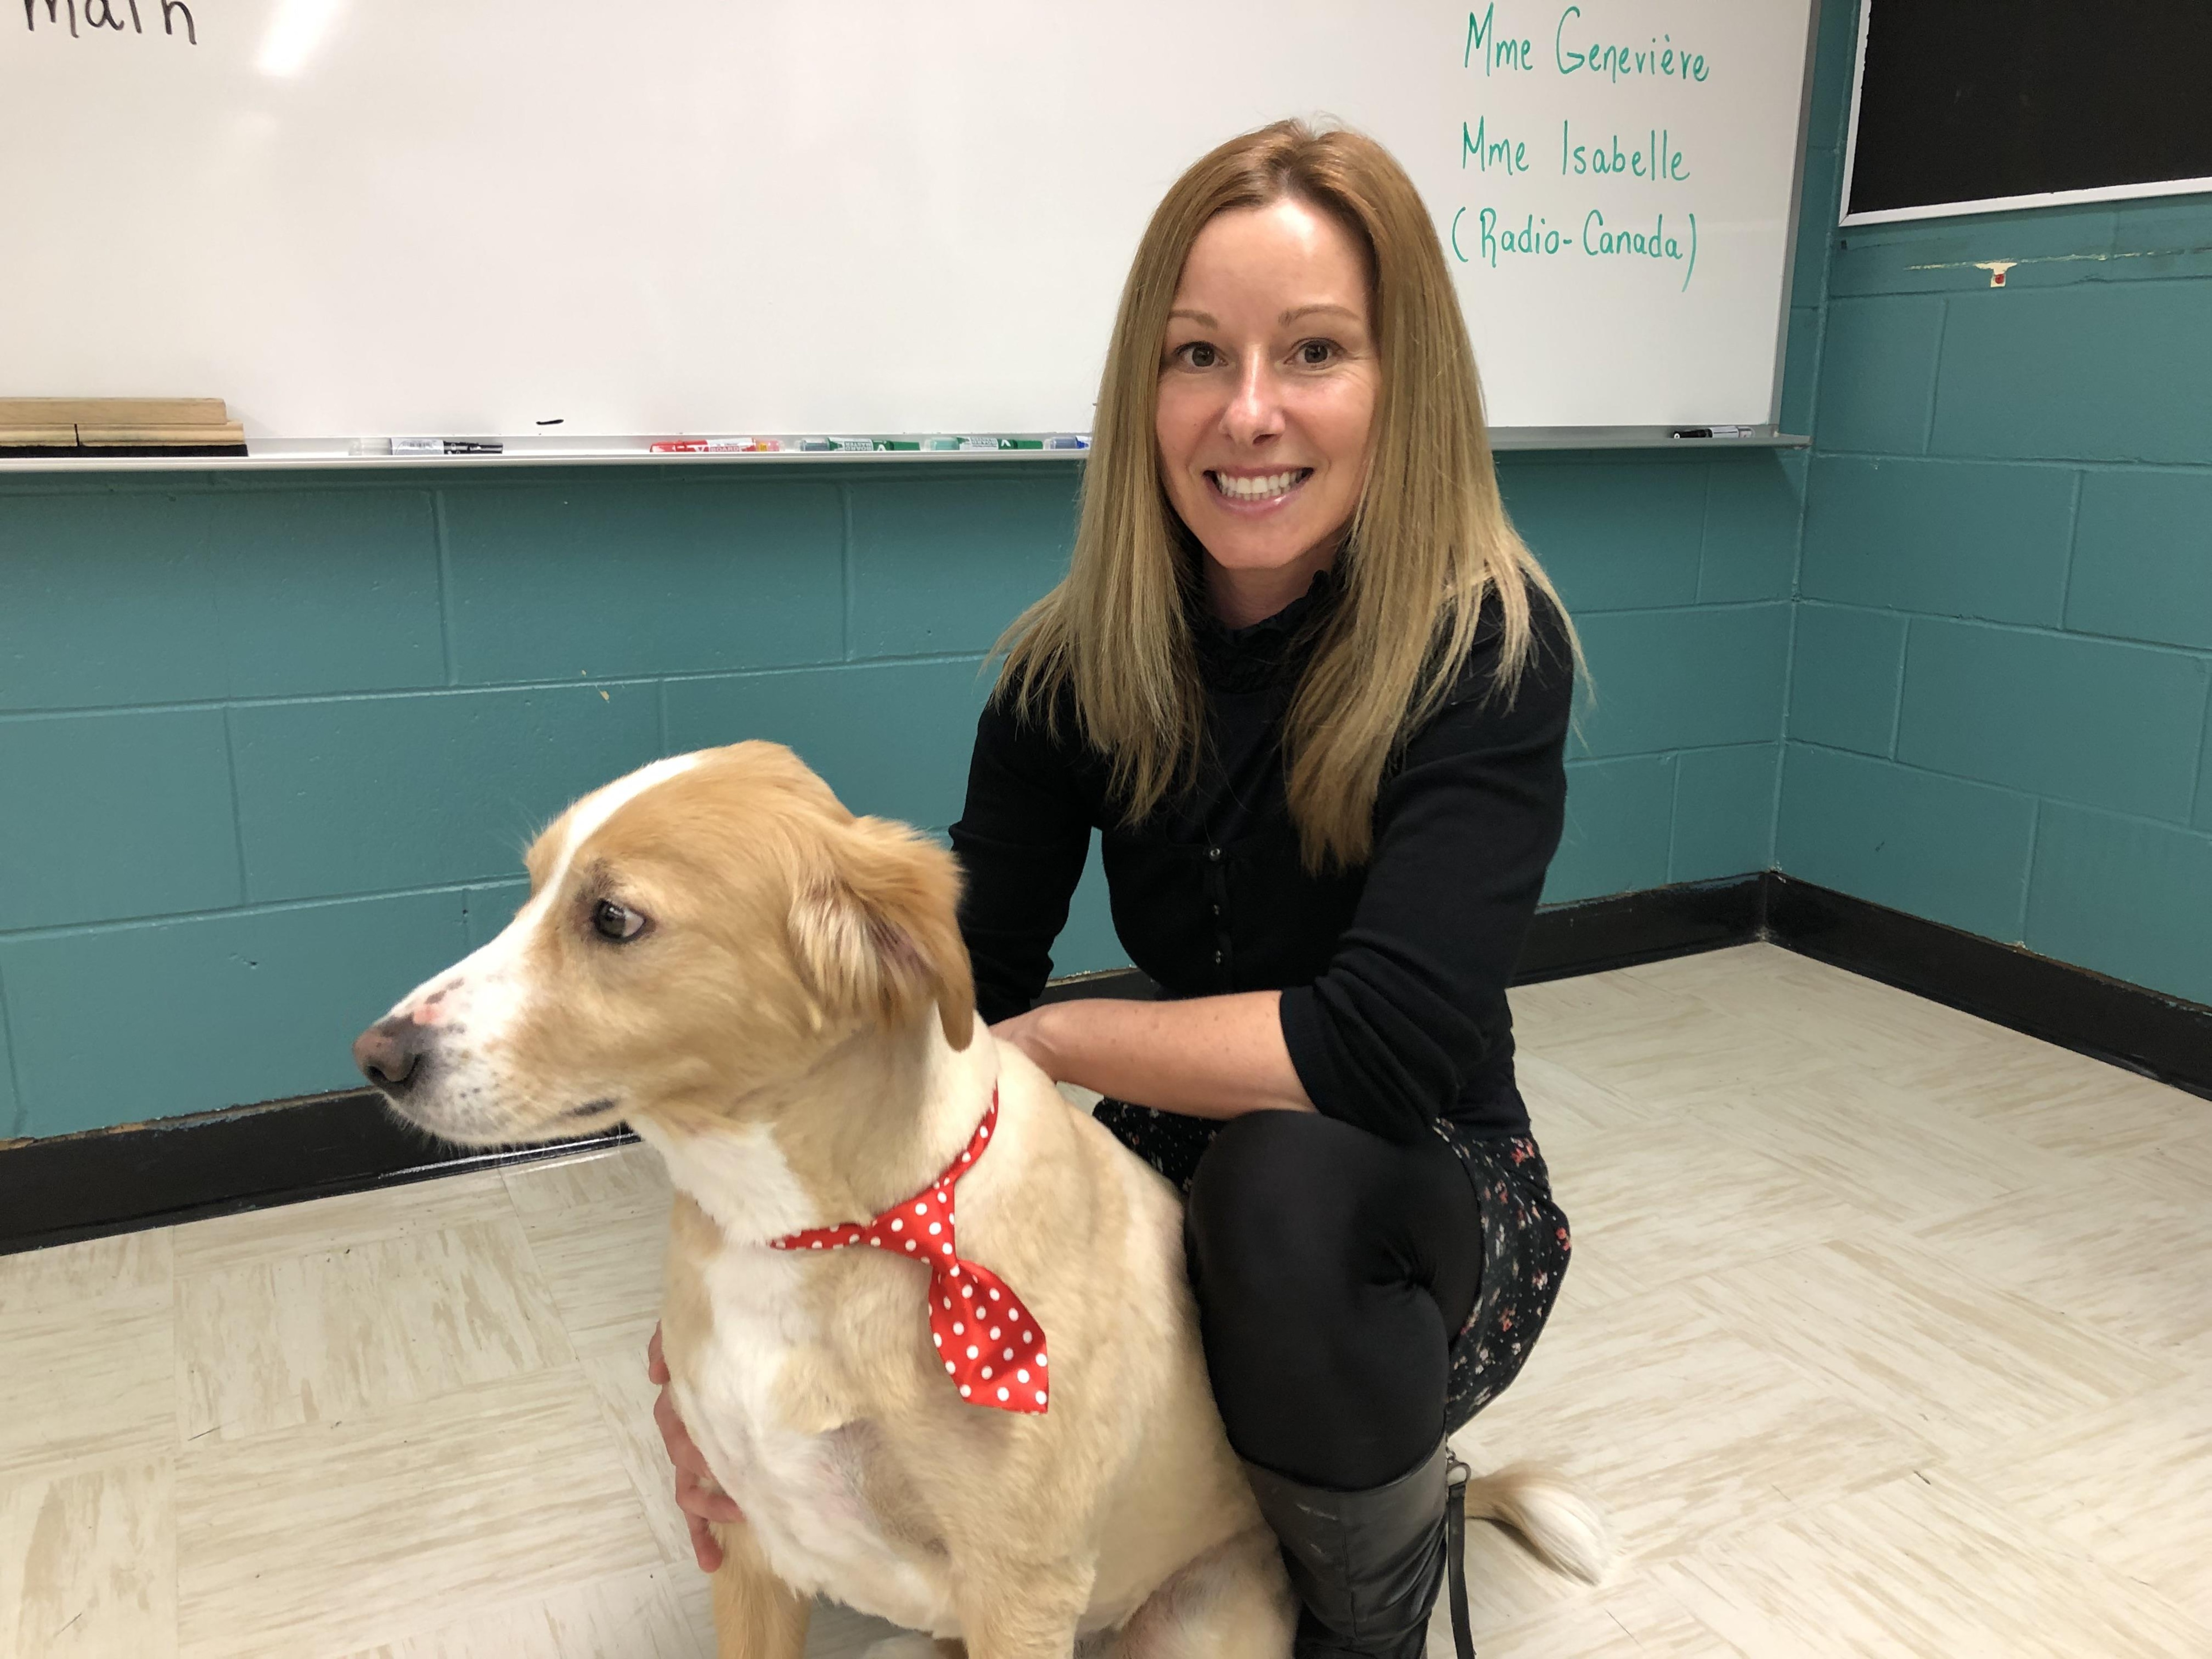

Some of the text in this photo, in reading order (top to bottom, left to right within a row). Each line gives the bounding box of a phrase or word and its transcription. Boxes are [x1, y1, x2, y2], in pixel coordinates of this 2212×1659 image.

[1464, 2, 1533, 77] Mme
[1462, 115, 1690, 181] Mme Isabelle
[1452, 206, 1697, 292] (Radio-Canada)
